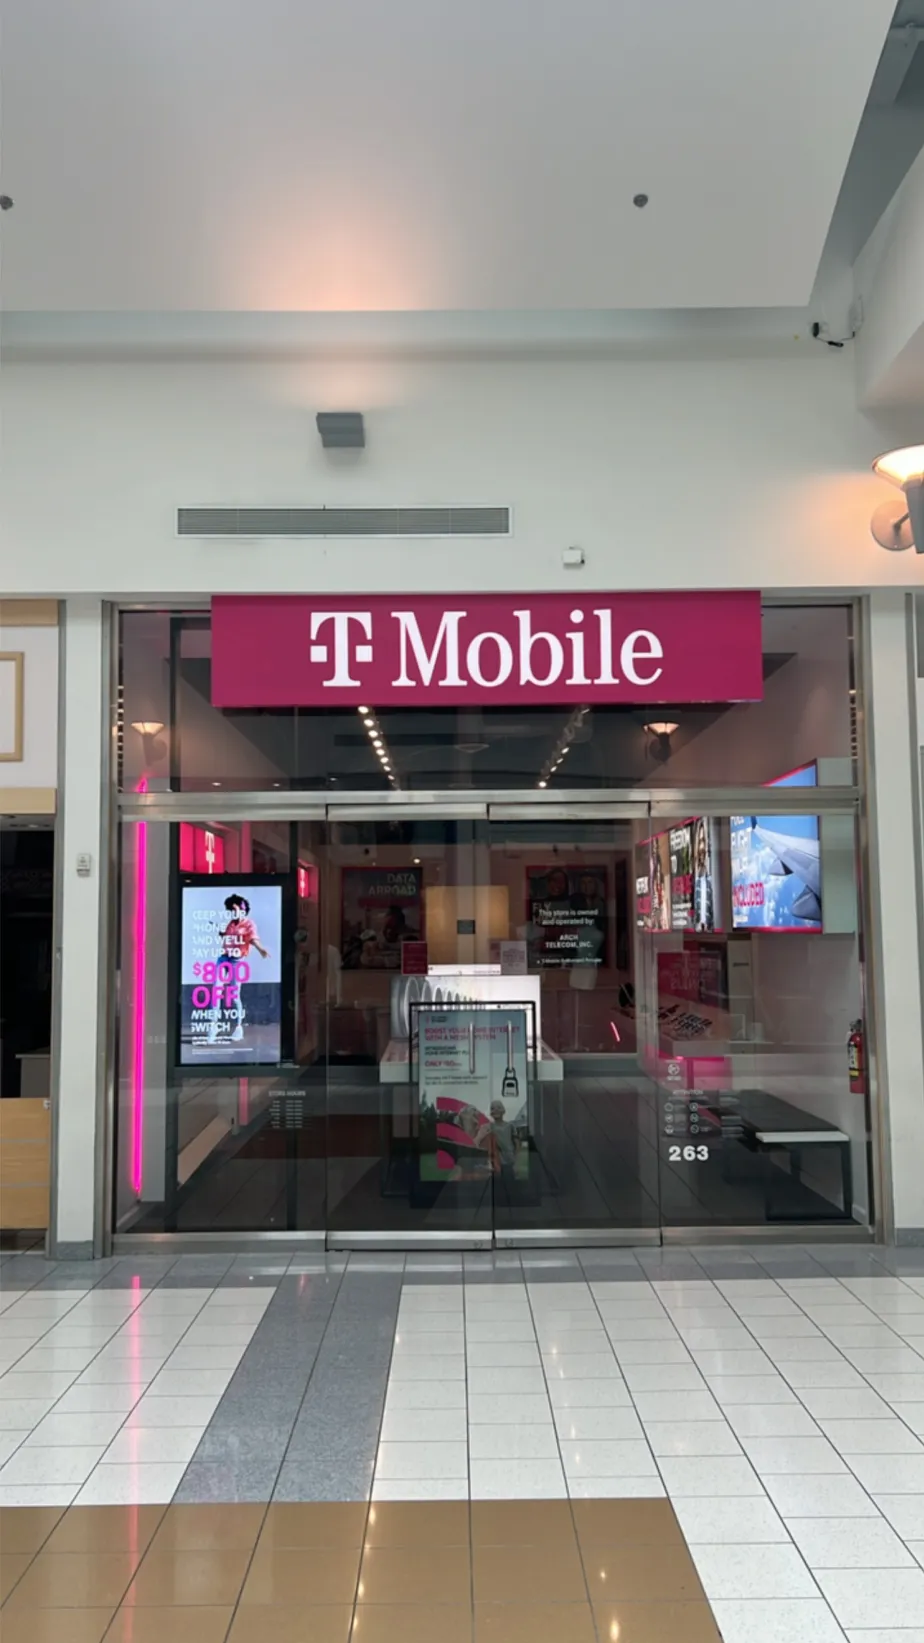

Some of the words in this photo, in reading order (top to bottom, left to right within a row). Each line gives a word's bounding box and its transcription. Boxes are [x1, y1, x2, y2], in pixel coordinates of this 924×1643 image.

[390, 609, 664, 688] Mobile
[387, 873, 417, 883] DATA
[368, 885, 417, 896] ABROAD
[218, 910, 246, 921] YOUR
[539, 909, 552, 917] This
[577, 908, 599, 916] owned
[542, 918, 555, 926] and
[556, 918, 583, 926] operated
[214, 935, 246, 945] WE'LL
[211, 947, 226, 957] UP
[227, 948, 242, 957] TO
[193, 961, 251, 984] $800
[192, 986, 239, 1009] OFF
[223, 1009, 246, 1020] YOU
[668, 1145, 709, 1162] 263
